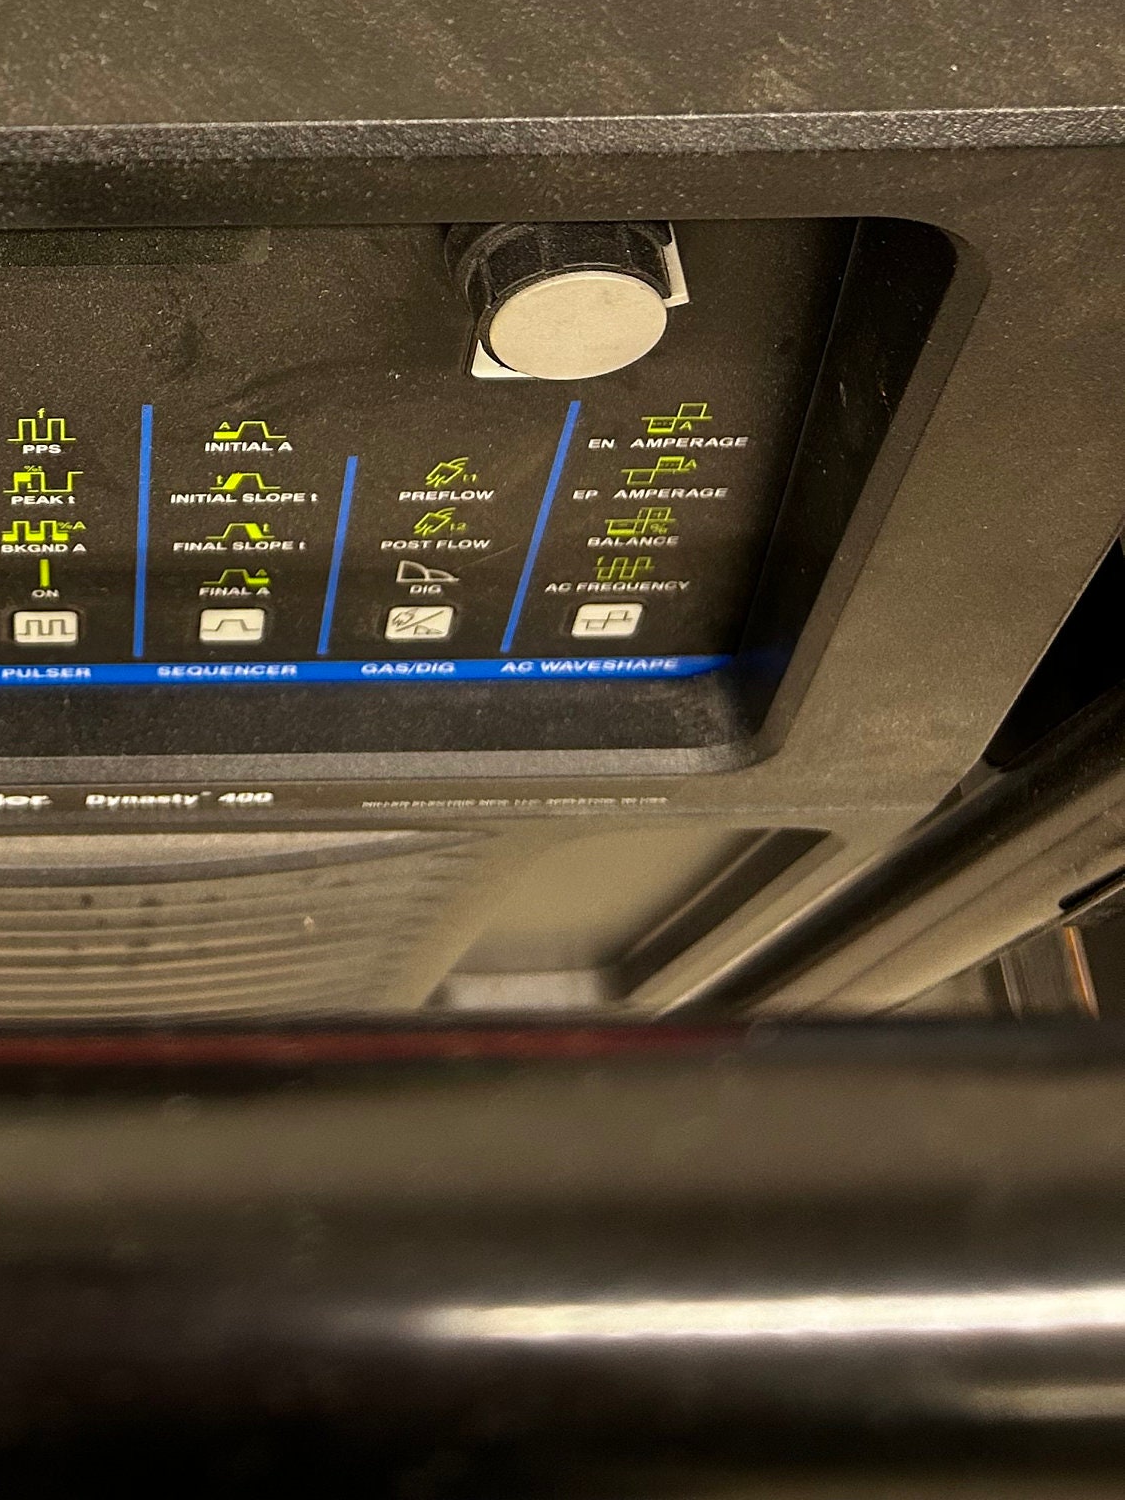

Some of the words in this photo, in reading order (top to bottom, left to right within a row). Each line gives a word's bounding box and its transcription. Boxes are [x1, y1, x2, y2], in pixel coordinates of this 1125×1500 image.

[204, 441, 274, 452] INITIAL
[277, 441, 293, 451] A
[588, 438, 615, 449] EN
[630, 436, 749, 449] AMPERAGE
[22, 444, 62, 455] PPS
[170, 493, 237, 504] INITIAL
[242, 492, 306, 503] SLOPE
[398, 489, 495, 501] PREFLOW
[572, 489, 599, 500] EP
[612, 487, 729, 500] AMPERAGE
[11, 495, 64, 505] PEAK
[173, 541, 227, 551] FINAL
[232, 540, 294, 551] SLOPE
[380, 539, 432, 550] POST
[436, 538, 491, 549] FLOW
[586, 535, 680, 548] BALANCE
[1, 543, 69, 554] BKGND
[72, 543, 87, 553] A
[198, 586, 252, 597] FINAL
[256, 586, 271, 596] A
[409, 584, 443, 595] DIG
[544, 582, 573, 594] AC
[576, 580, 691, 593] FREQUENCY
[31, 589, 60, 599] ON
[156, 664, 298, 678] SEQUENCER
[360, 661, 455, 676] GAS/DIG
[500, 660, 534, 674] AC
[540, 657, 680, 674] WAVESHAPE
[1, 666, 92, 680] PULSER
[217, 791, 274, 806] 400
